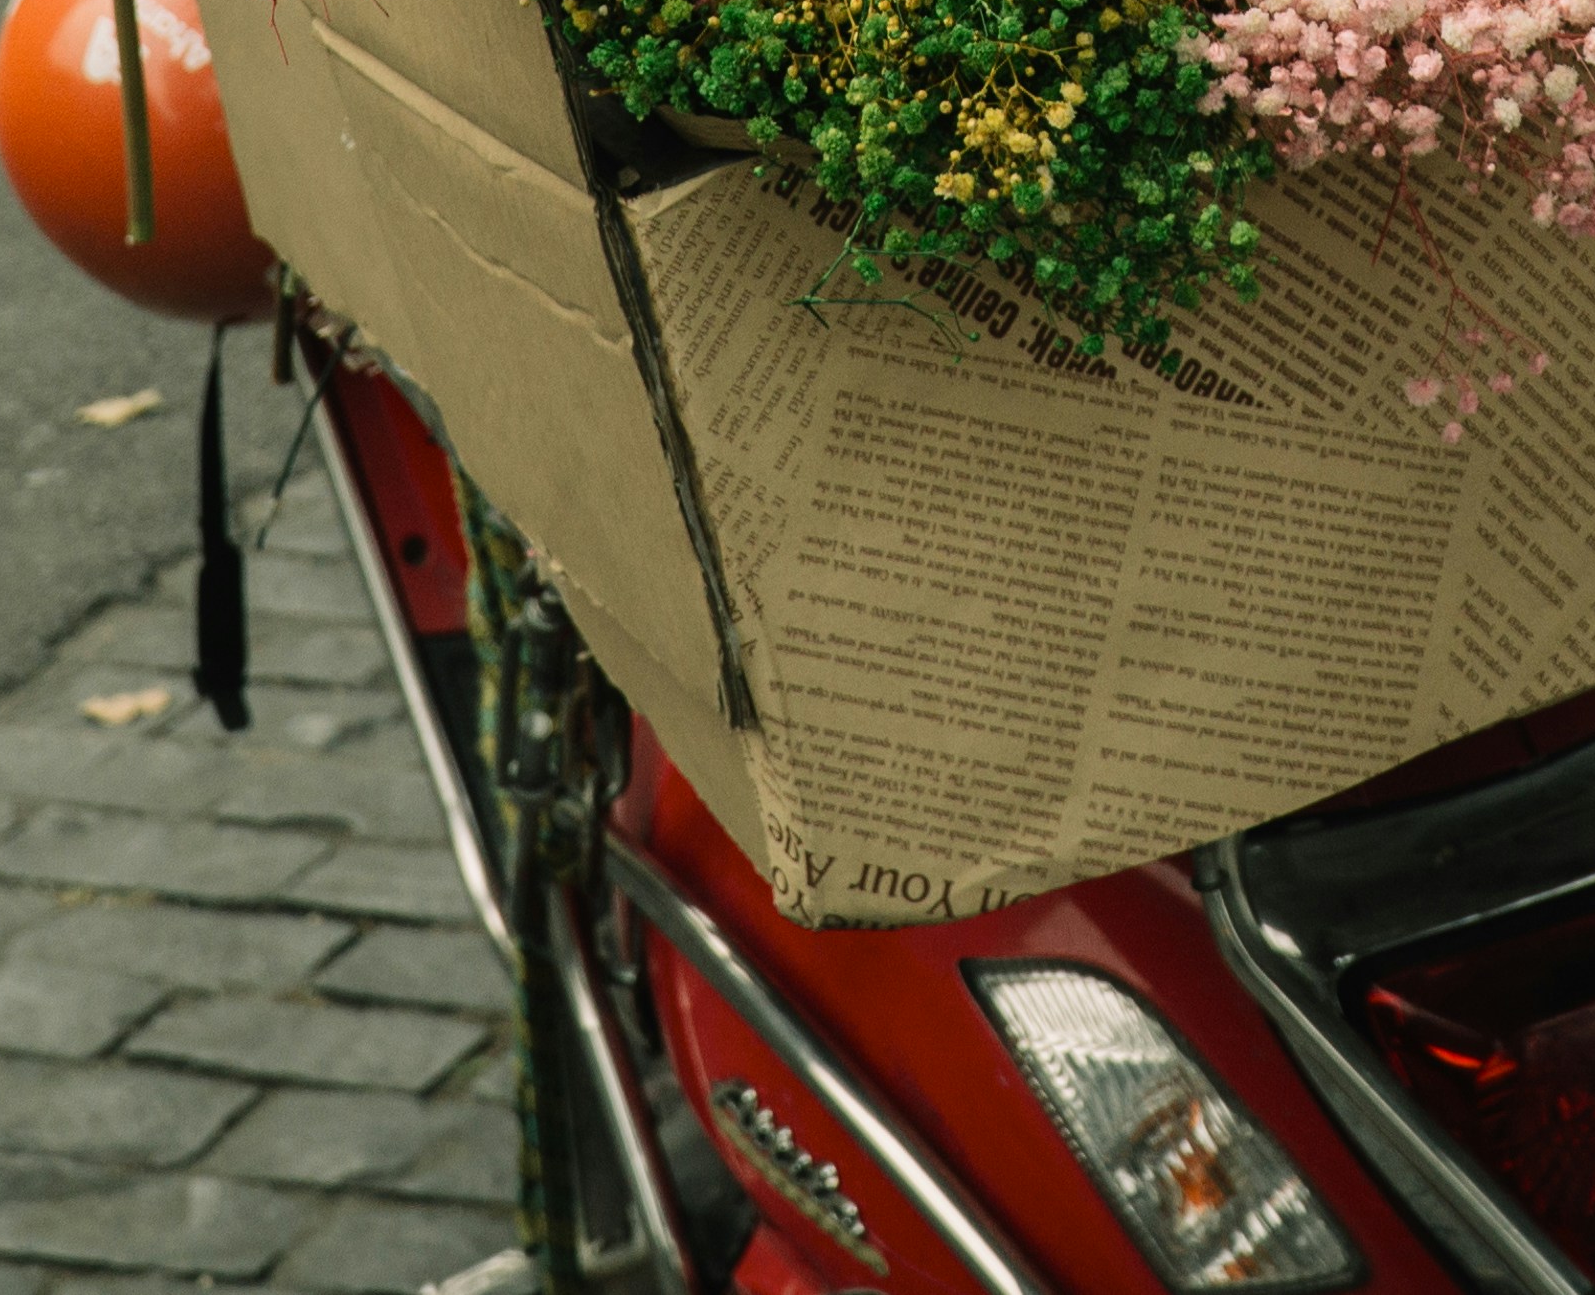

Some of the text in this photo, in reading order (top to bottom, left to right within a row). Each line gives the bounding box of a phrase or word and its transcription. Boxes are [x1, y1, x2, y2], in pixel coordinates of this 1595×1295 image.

[689, 213, 732, 276] to your
[719, 224, 747, 259] with
[681, 219, 770, 368] earnest and sincere
[691, 250, 774, 382] can immediately
[765, 314, 783, 333] to
[784, 345, 807, 376] can
[750, 384, 786, 435] smoke
[785, 368, 819, 415] world
[706, 402, 730, 437] and
[723, 403, 751, 444] cigar
[772, 433, 804, 472] from
[850, 863, 957, 919] Your
